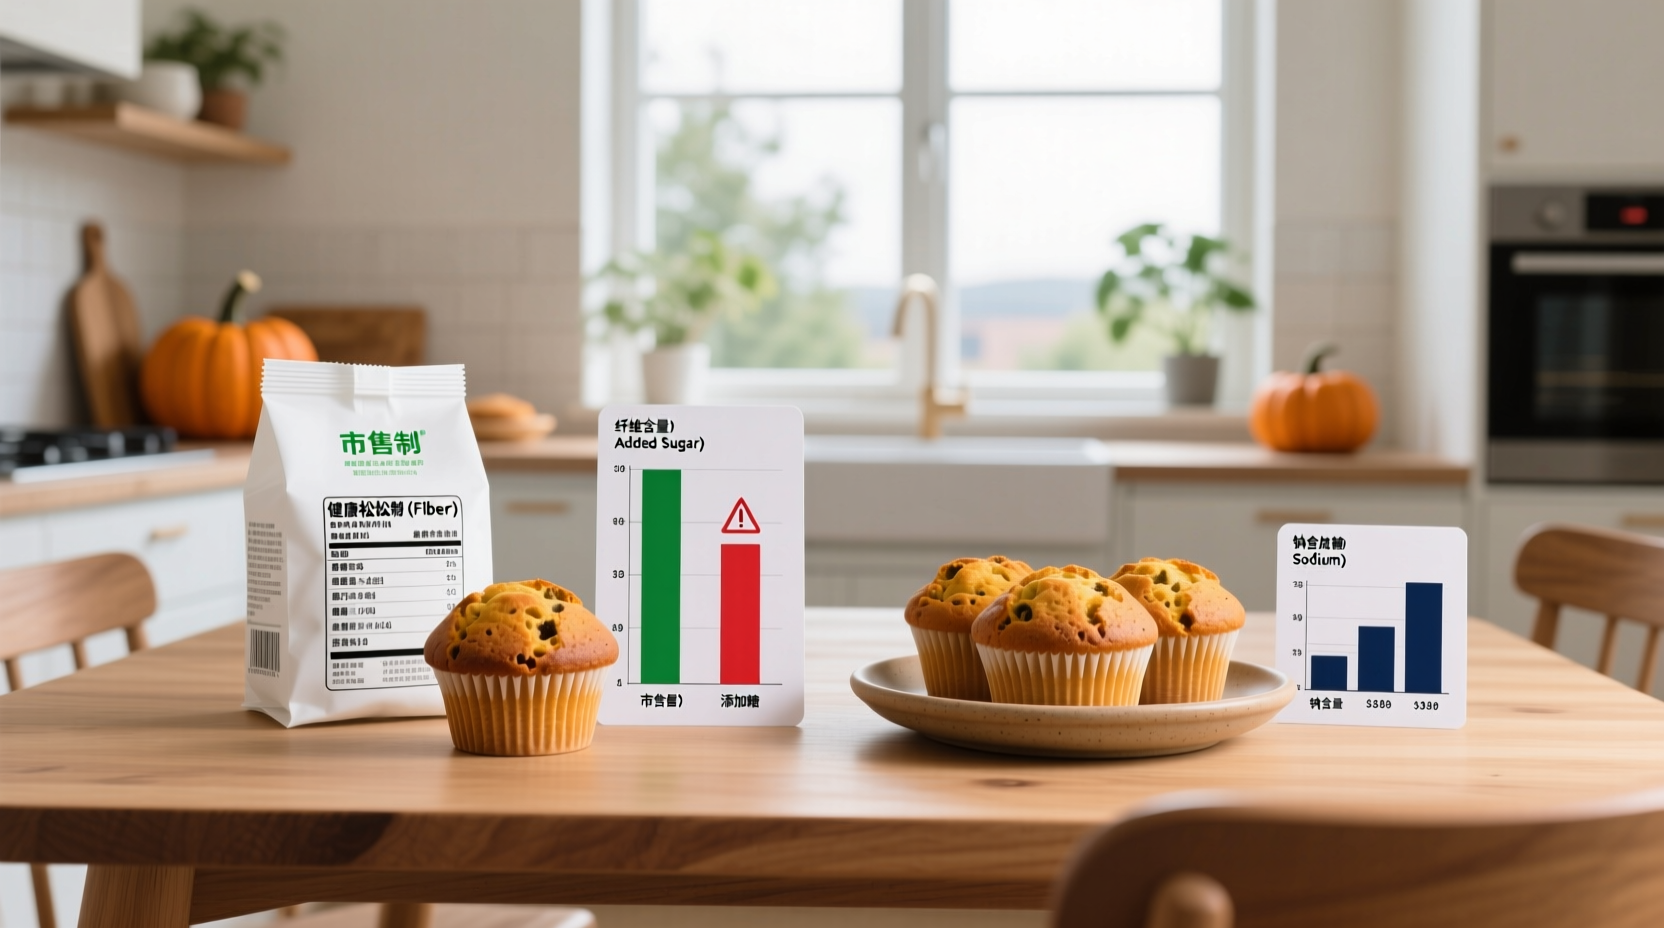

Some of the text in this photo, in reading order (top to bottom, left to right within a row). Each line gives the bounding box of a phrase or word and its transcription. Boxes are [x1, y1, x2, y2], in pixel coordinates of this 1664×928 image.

[339, 430, 421, 456] 市售制
[614, 436, 705, 452] Added Sugar)
[1292, 552, 1347, 568] Sodium)
